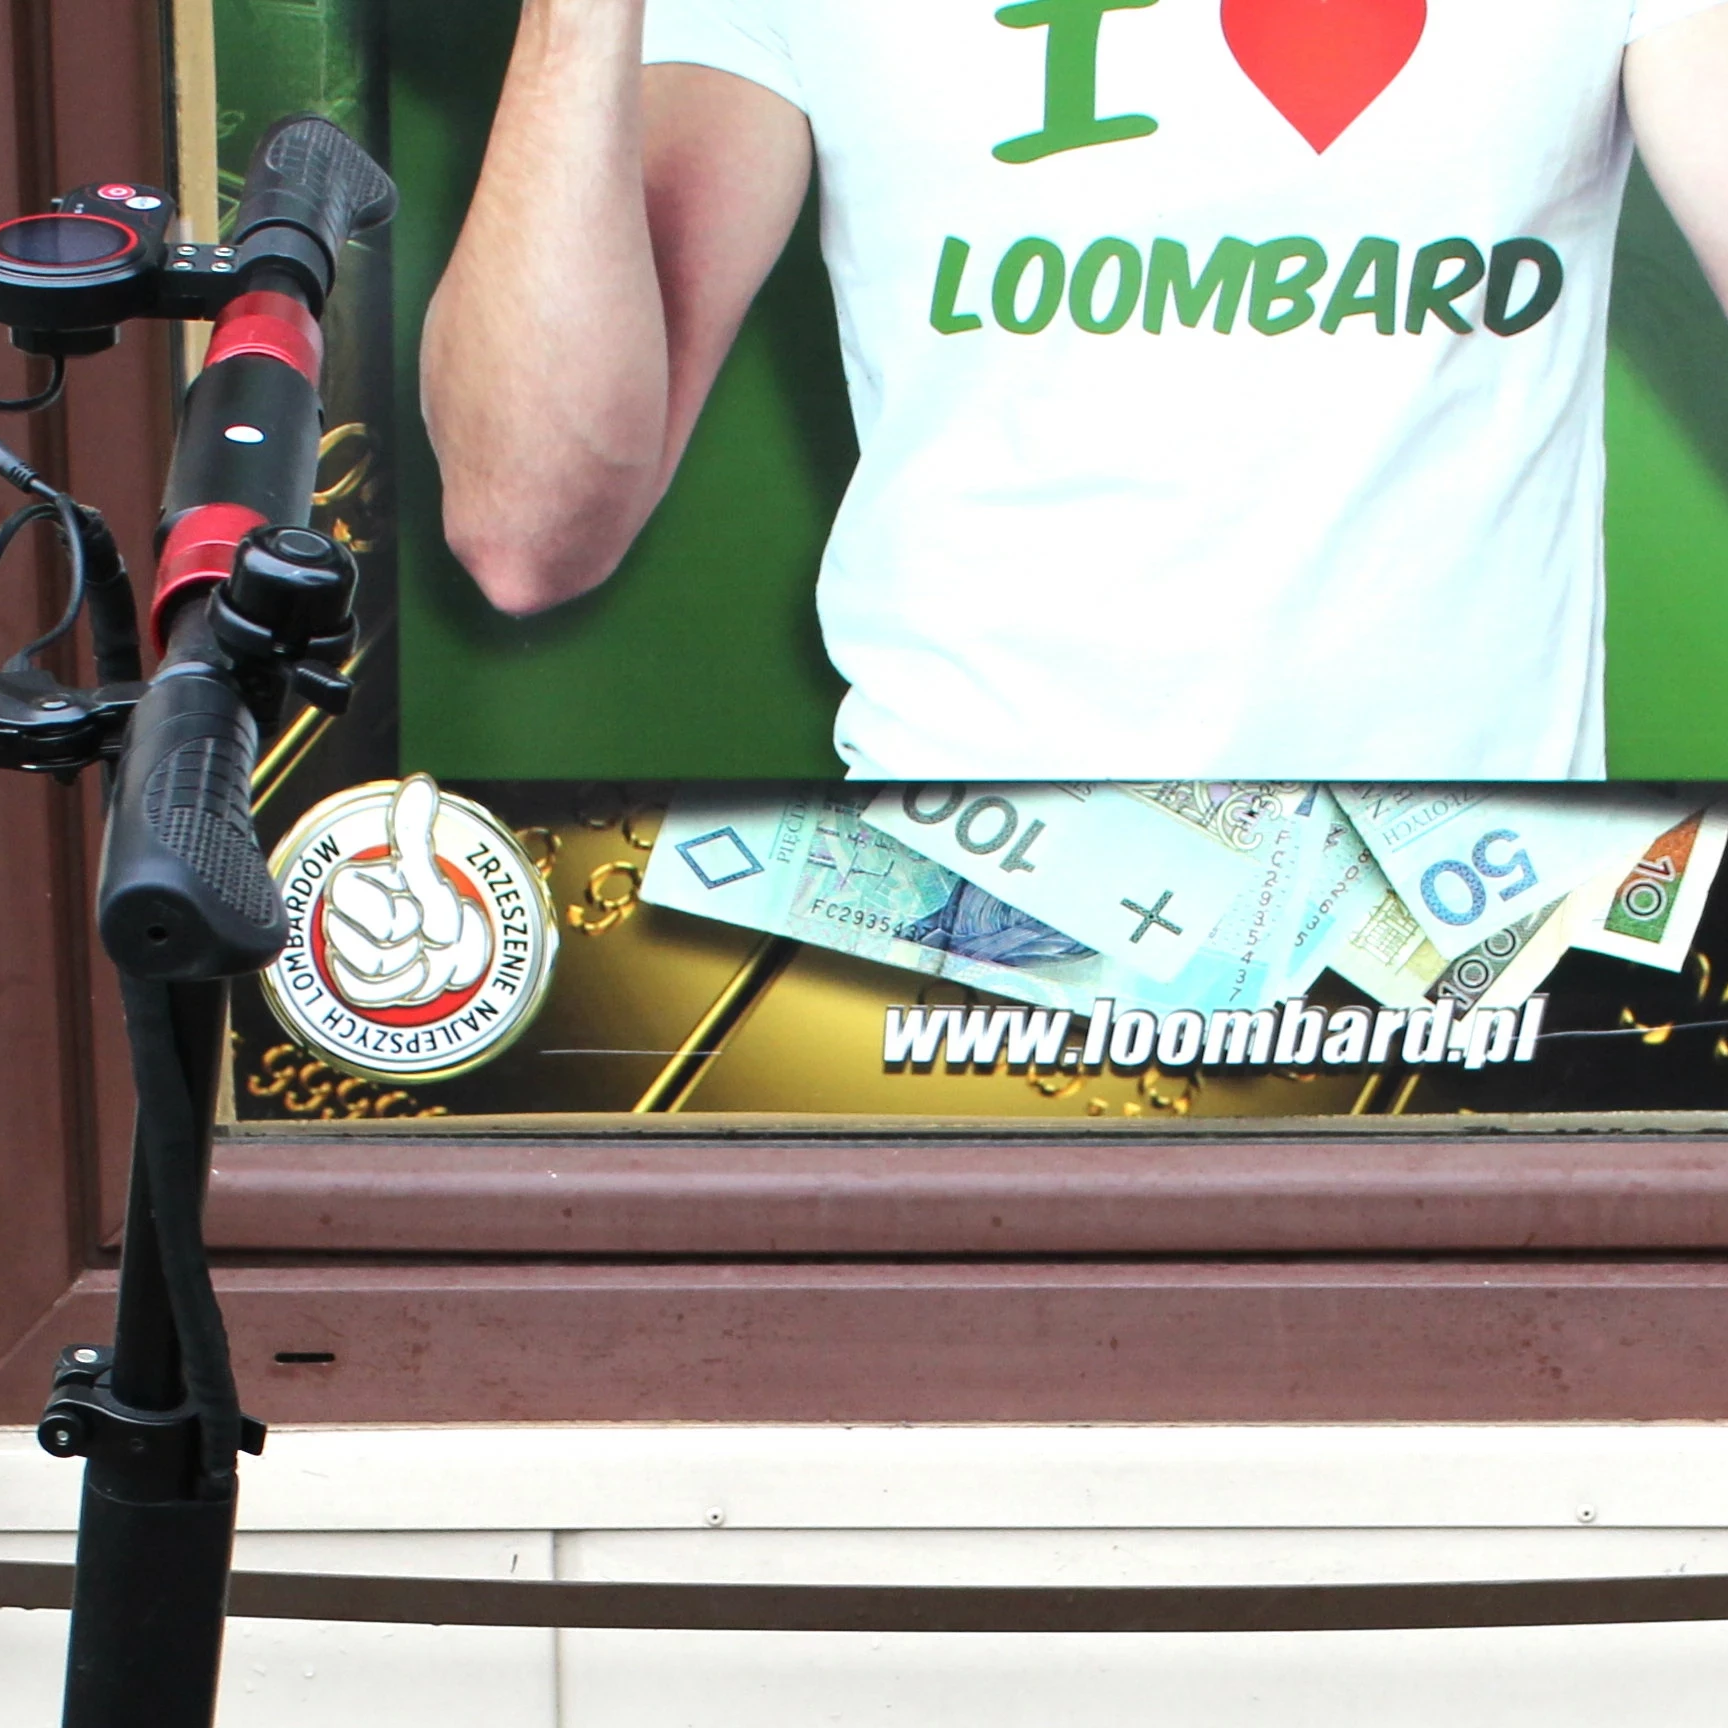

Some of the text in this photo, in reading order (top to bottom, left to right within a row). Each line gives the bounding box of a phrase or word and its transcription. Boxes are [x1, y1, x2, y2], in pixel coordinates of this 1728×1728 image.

[929, 235, 1565, 338] LOOMBARD
[1419, 828, 1540, 927] 50
[1619, 854, 1676, 922] 10
[284, 833, 529, 1054] ZRZESZENIE NAJLEPSZYCH LOMBARDÓW
[882, 997, 1544, 1070] www.loombard.pl
